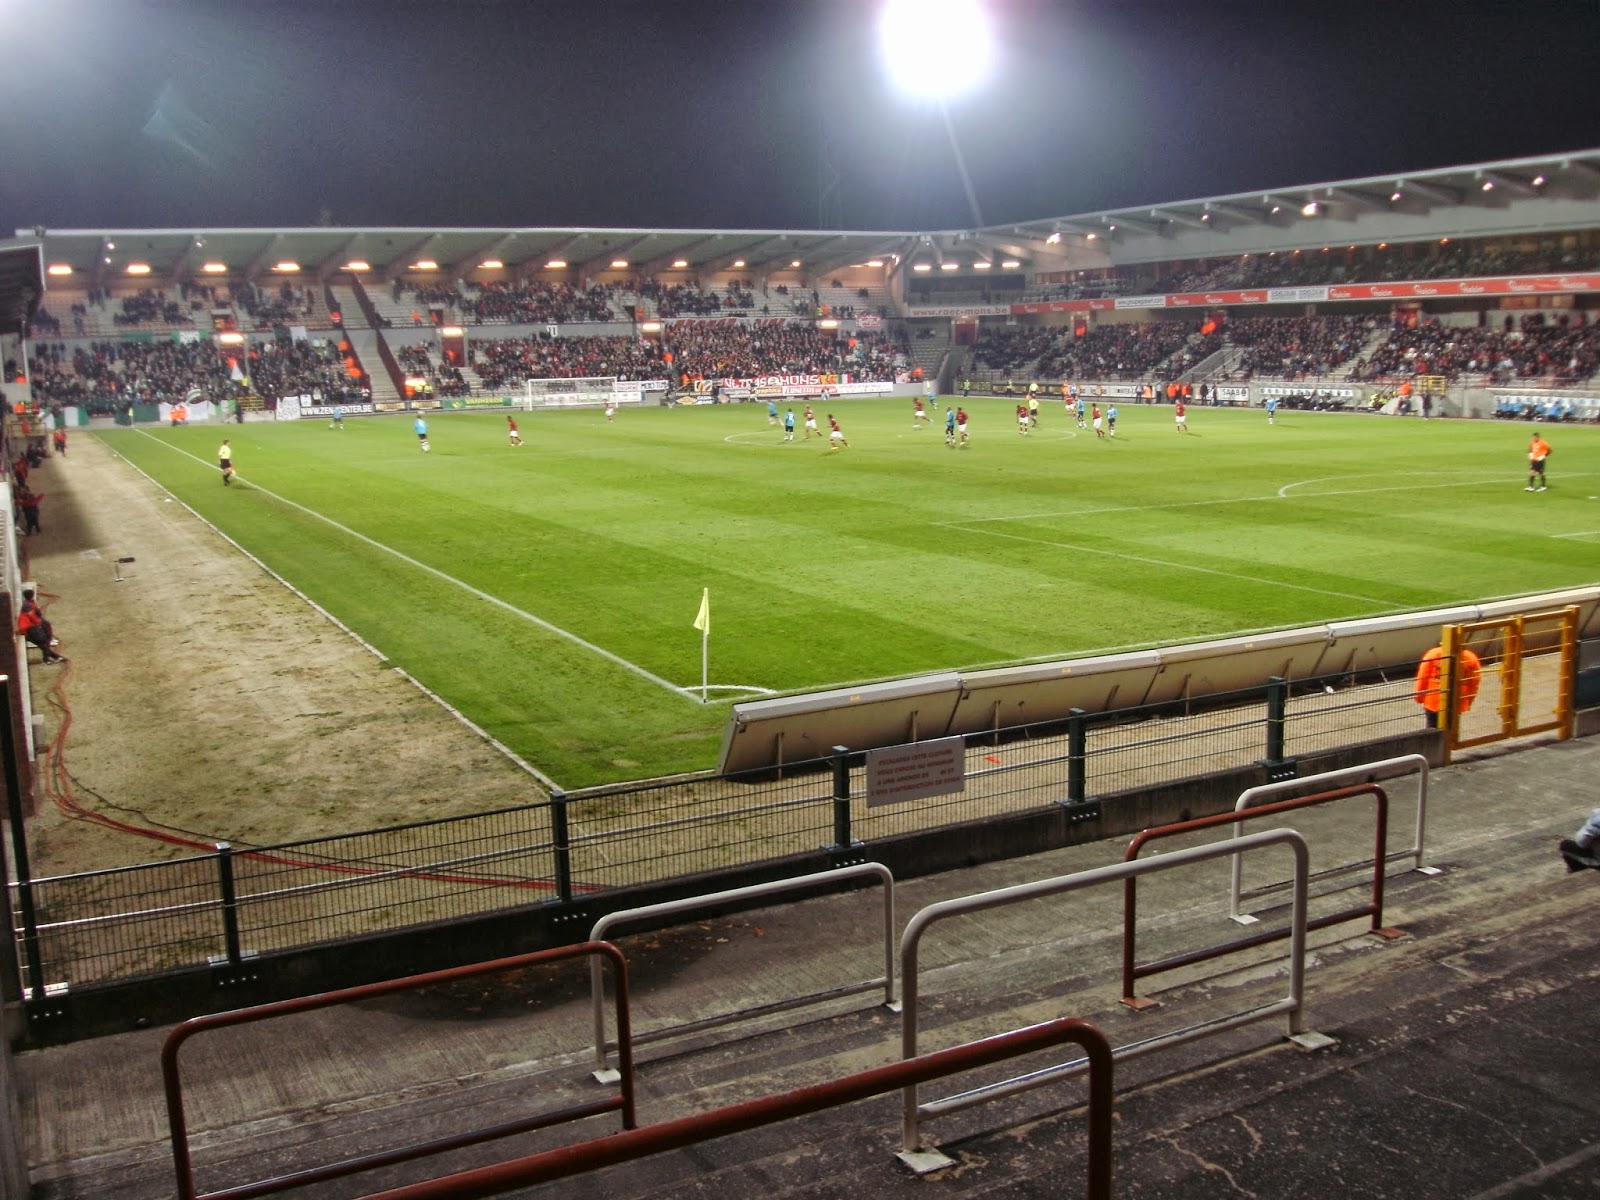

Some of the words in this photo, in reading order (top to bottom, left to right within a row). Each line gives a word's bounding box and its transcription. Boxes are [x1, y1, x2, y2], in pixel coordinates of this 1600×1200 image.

[912, 306, 1007, 316] www.raec-mons.be
[1222, 388, 1240, 396] SAAB
[301, 405, 372, 415] WWW.ZENENTER.BE
